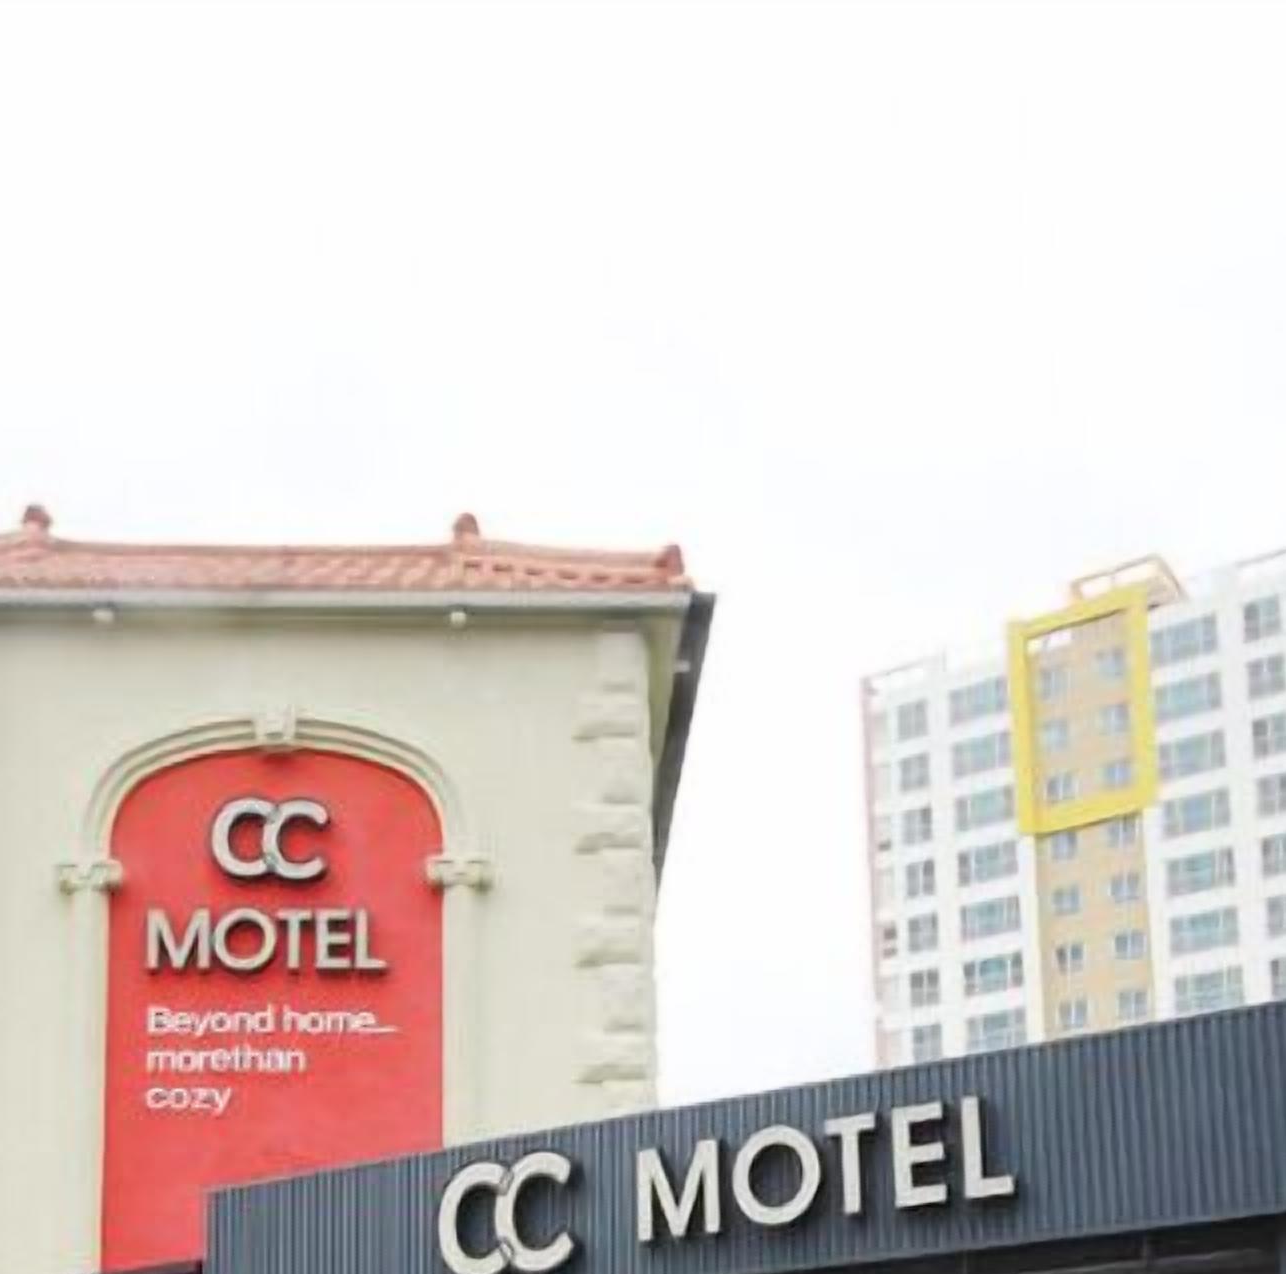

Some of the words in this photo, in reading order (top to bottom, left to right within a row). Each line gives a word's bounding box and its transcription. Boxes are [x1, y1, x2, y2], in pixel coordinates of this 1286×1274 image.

[145, 906, 388, 974] MOTEL
[147, 1004, 275, 1037] Beyond
[145, 1086, 232, 1115] cozy
[636, 1096, 1015, 1243] MOTEL
